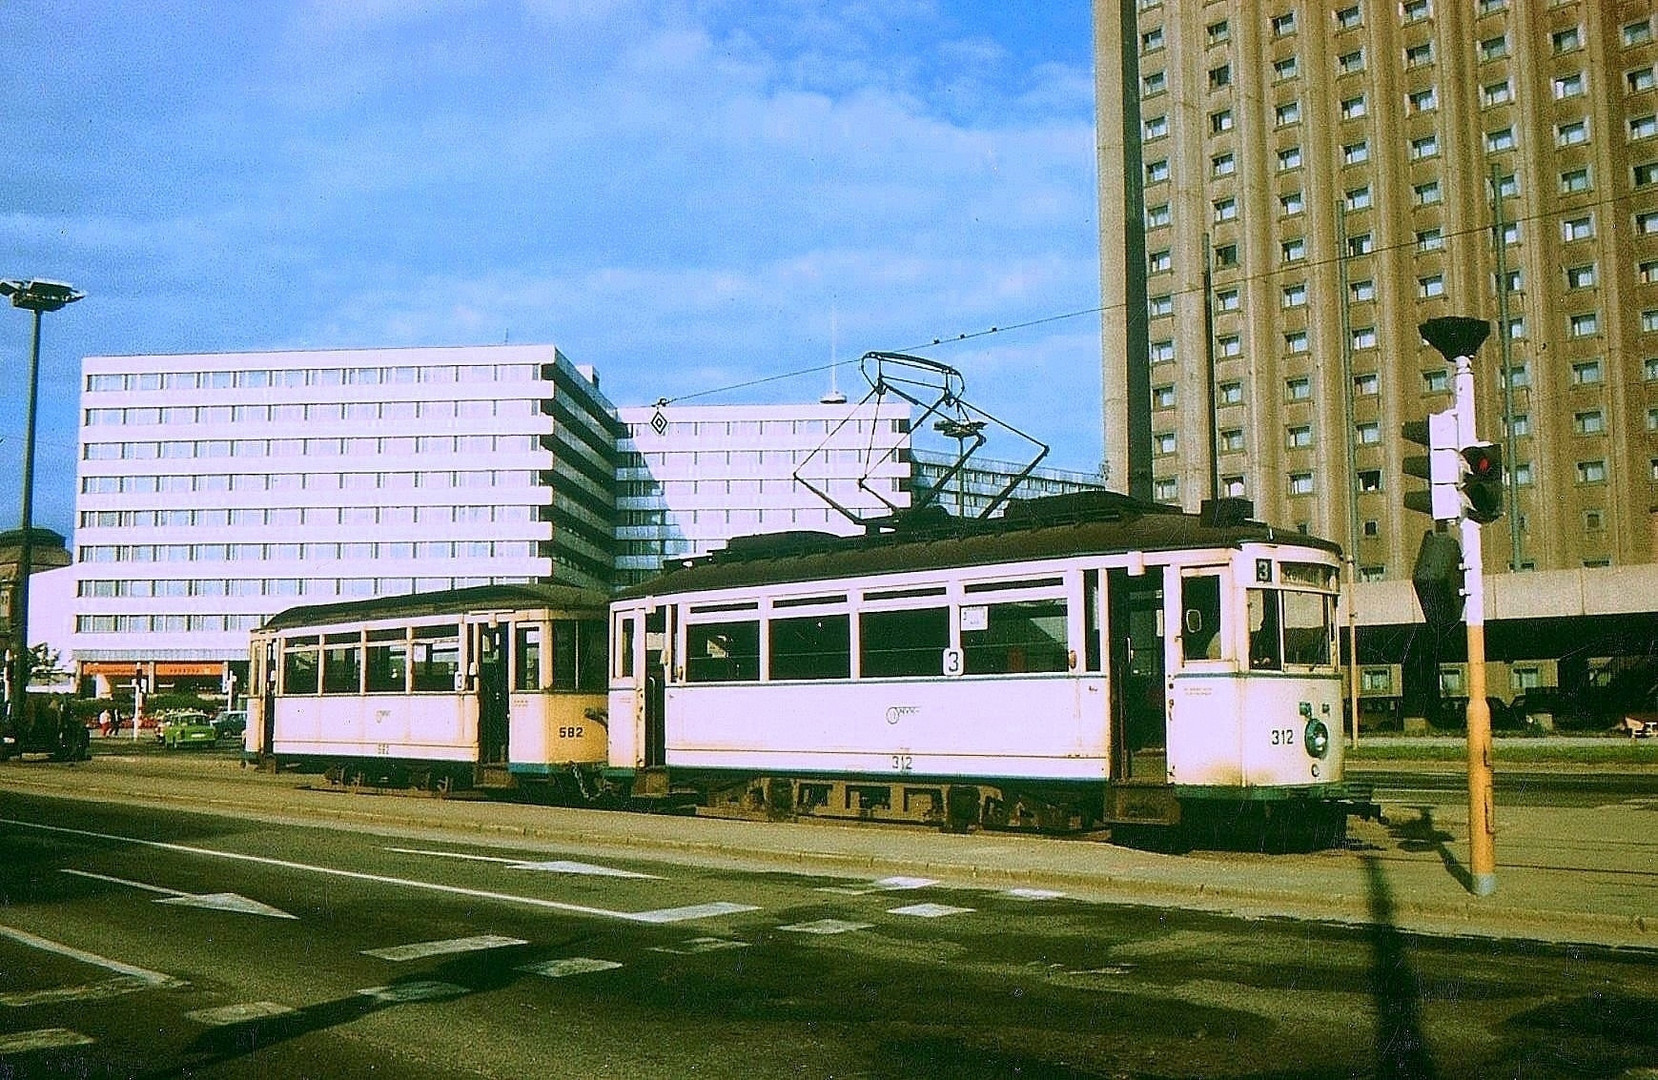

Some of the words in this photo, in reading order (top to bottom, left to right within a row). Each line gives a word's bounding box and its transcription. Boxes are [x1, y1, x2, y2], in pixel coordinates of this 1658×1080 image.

[1258, 561, 1269, 579] 3
[948, 651, 959, 672] 3
[559, 727, 584, 738] 582
[1271, 729, 1294, 745] 312
[892, 755, 913, 770] 312
